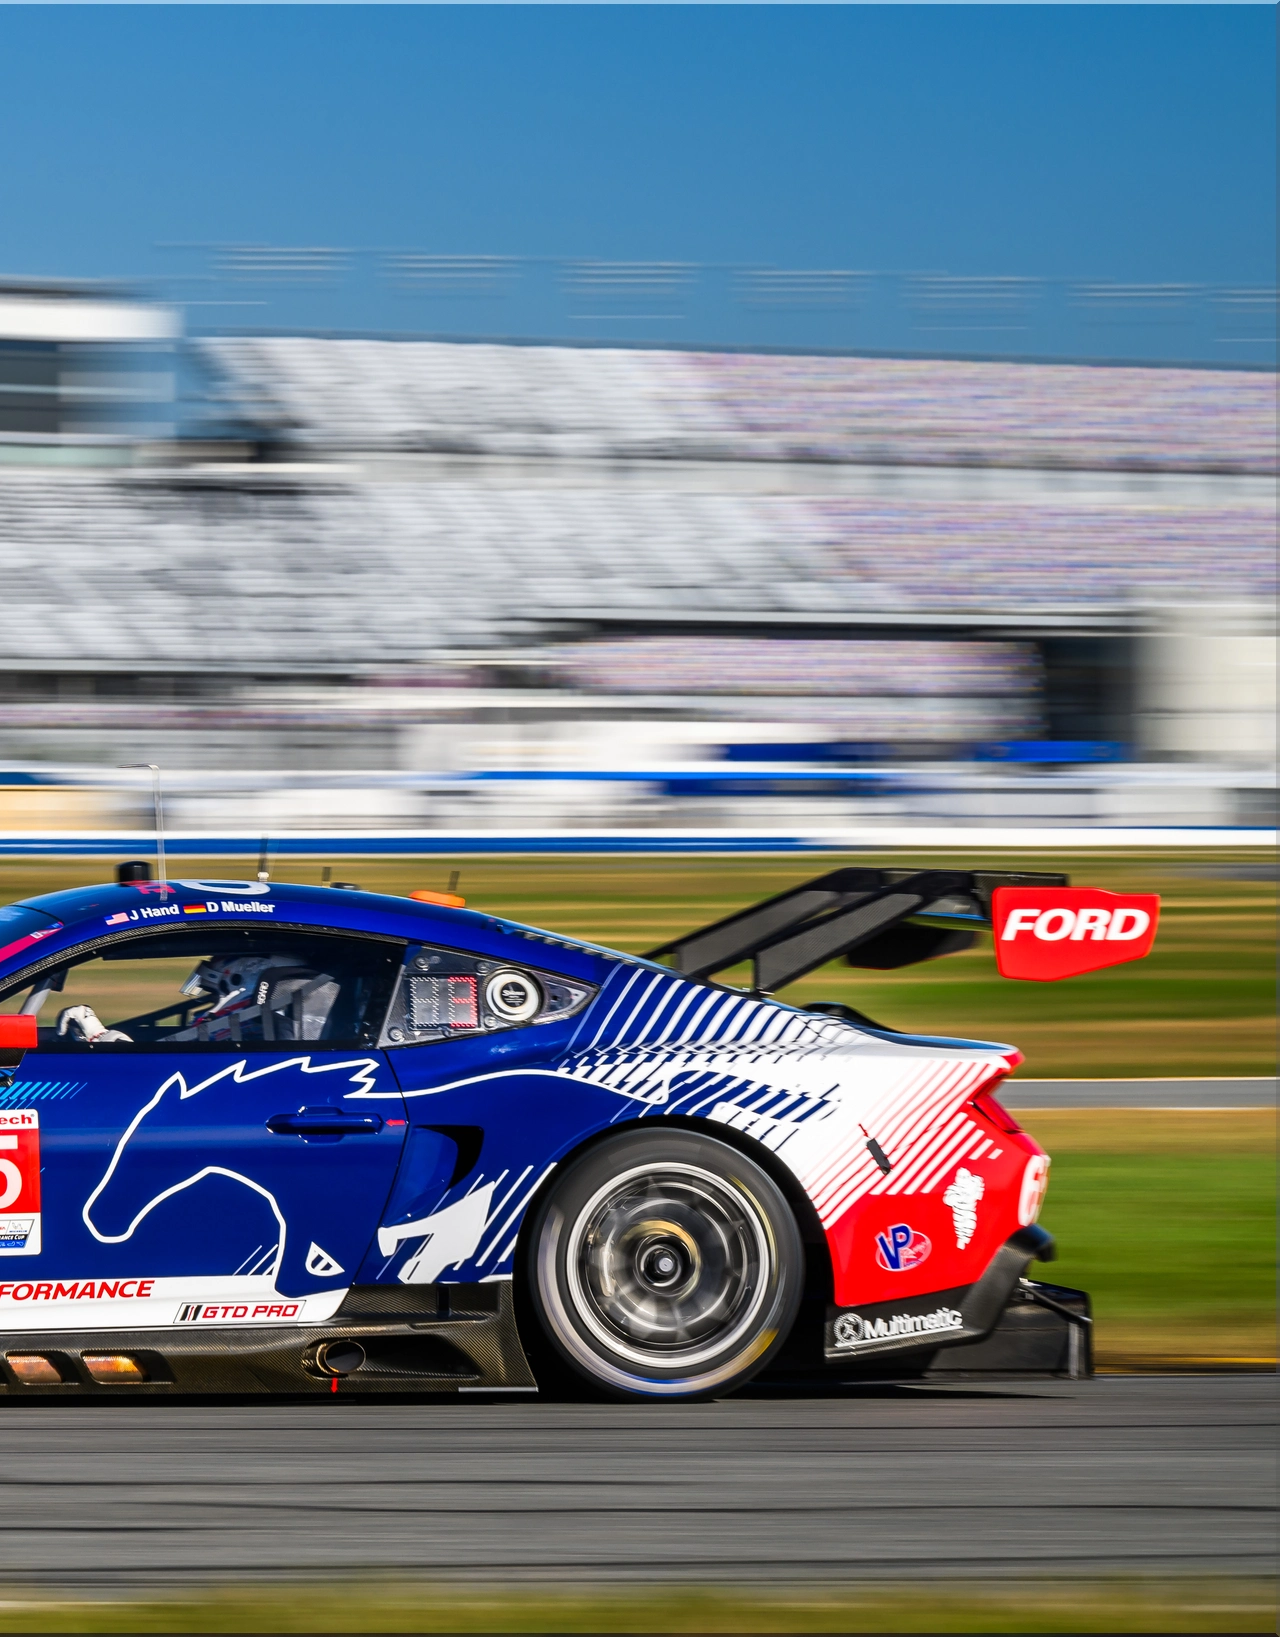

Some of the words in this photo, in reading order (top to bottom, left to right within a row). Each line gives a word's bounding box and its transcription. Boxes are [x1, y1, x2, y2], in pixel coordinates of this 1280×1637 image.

[129, 910, 140, 920] J
[140, 903, 180, 919] Hand
[206, 901, 219, 913] D
[221, 901, 276, 913] Mueller
[1001, 908, 1151, 941] FORD
[876, 1223, 912, 1270] VP
[202, 1305, 249, 1319] GTD
[251, 1304, 299, 1318] PRO
[863, 1307, 963, 1339] Multimatic
